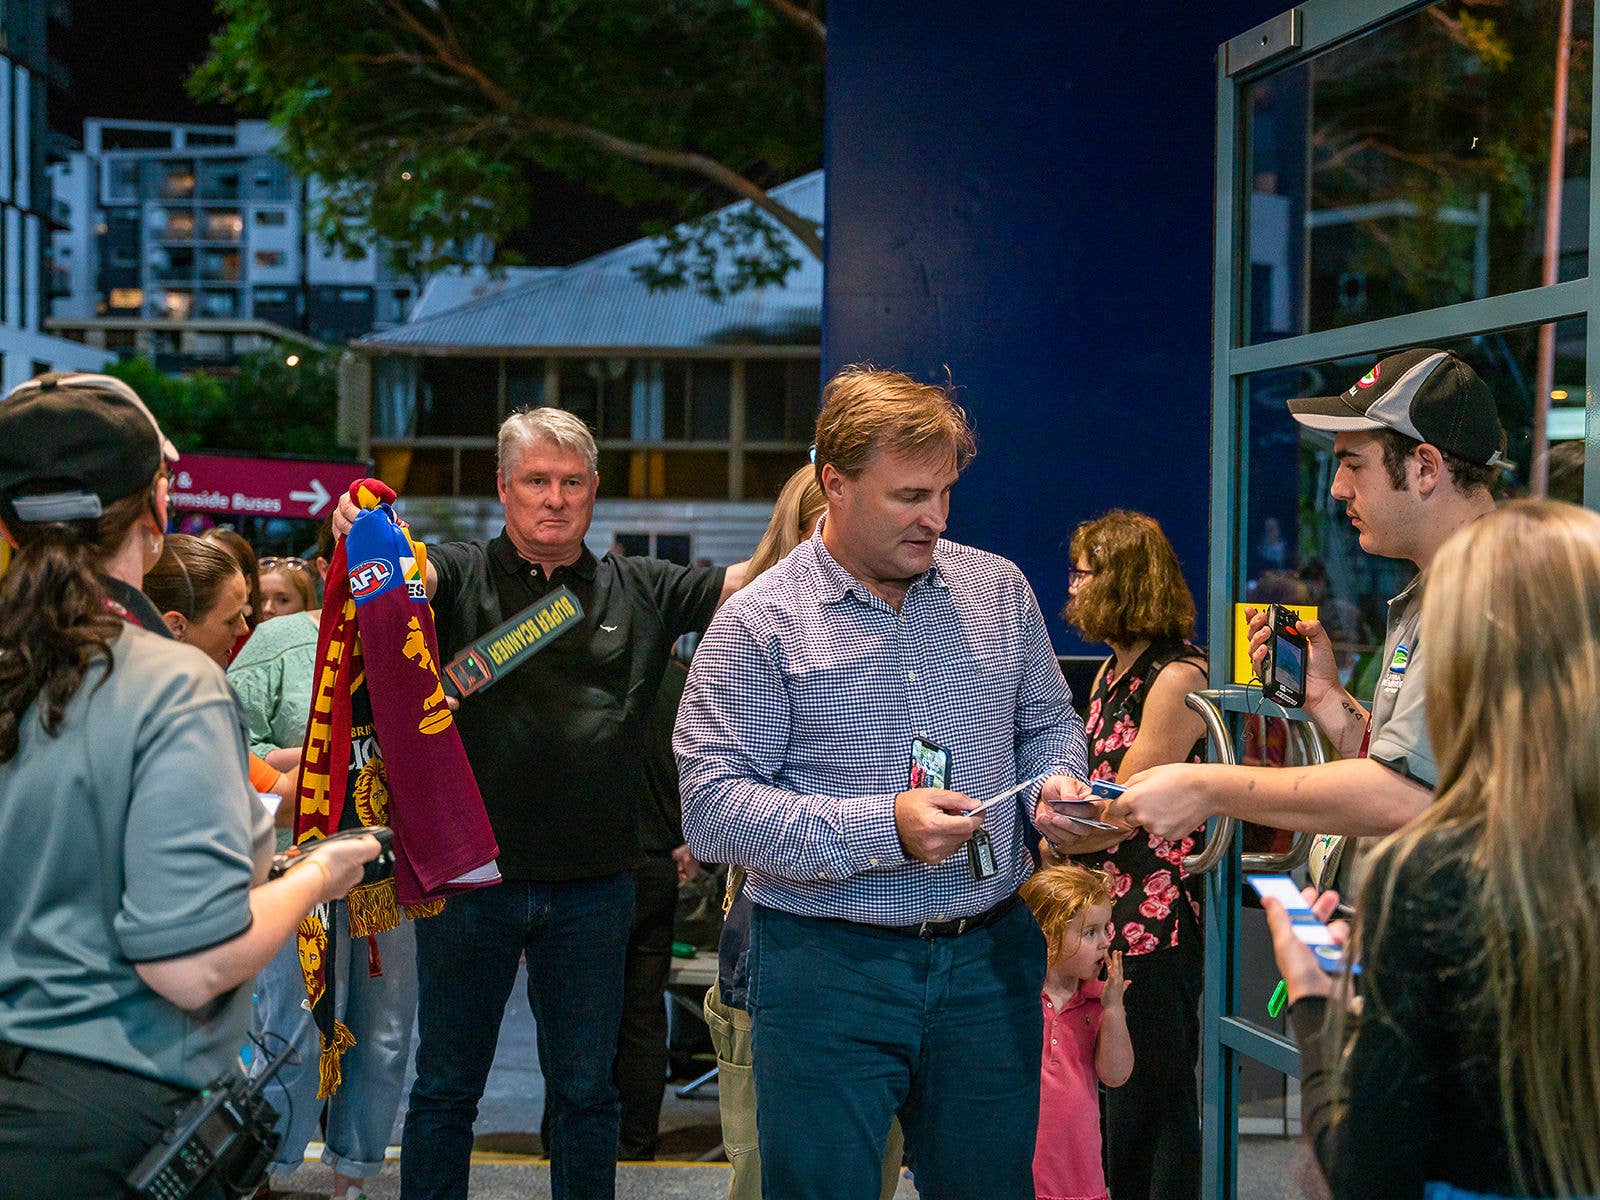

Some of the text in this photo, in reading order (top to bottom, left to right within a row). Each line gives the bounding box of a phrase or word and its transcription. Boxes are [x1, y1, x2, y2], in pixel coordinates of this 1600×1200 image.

[232, 493, 281, 513] Buses
[349, 564, 391, 594] AFL
[487, 595, 576, 666] SUPER SCANNER
